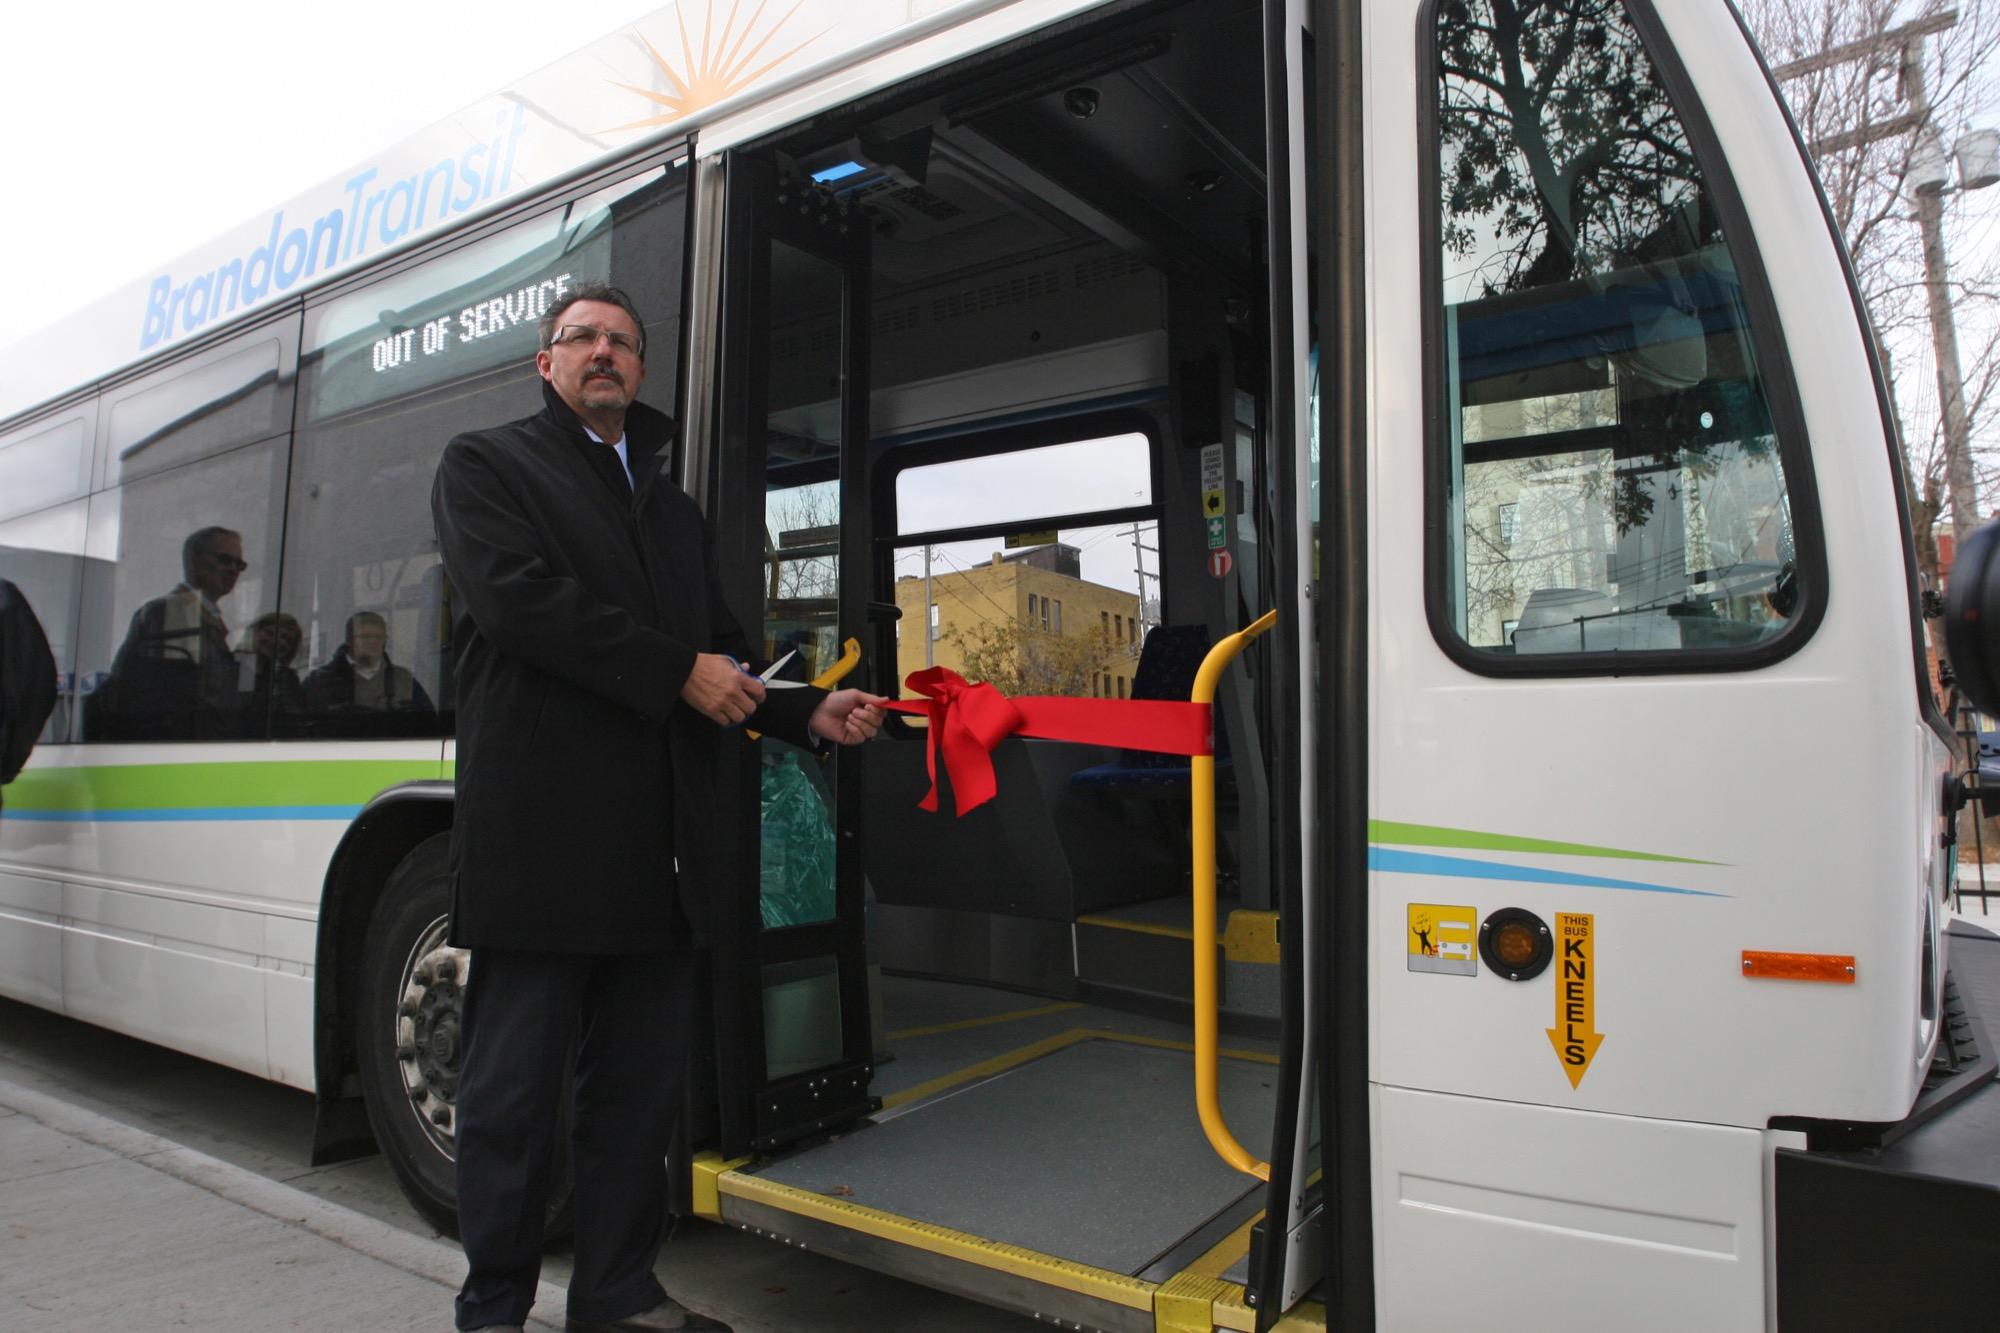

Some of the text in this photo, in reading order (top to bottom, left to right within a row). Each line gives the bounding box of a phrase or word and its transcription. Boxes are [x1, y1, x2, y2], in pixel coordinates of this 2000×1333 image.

[372, 272, 572, 372] OUT OF SERVICE
[1204, 449, 1221, 457] PLEASE
[1205, 456, 1220, 464] STAND
[1204, 463, 1222, 471] BEHIND
[1208, 469, 1217, 477] THE
[1204, 476, 1222, 484] YELLOW
[1563, 916, 1589, 926] THIS
[1564, 927, 1588, 937] BUS
[1564, 938, 1586, 1066] KNEELS
